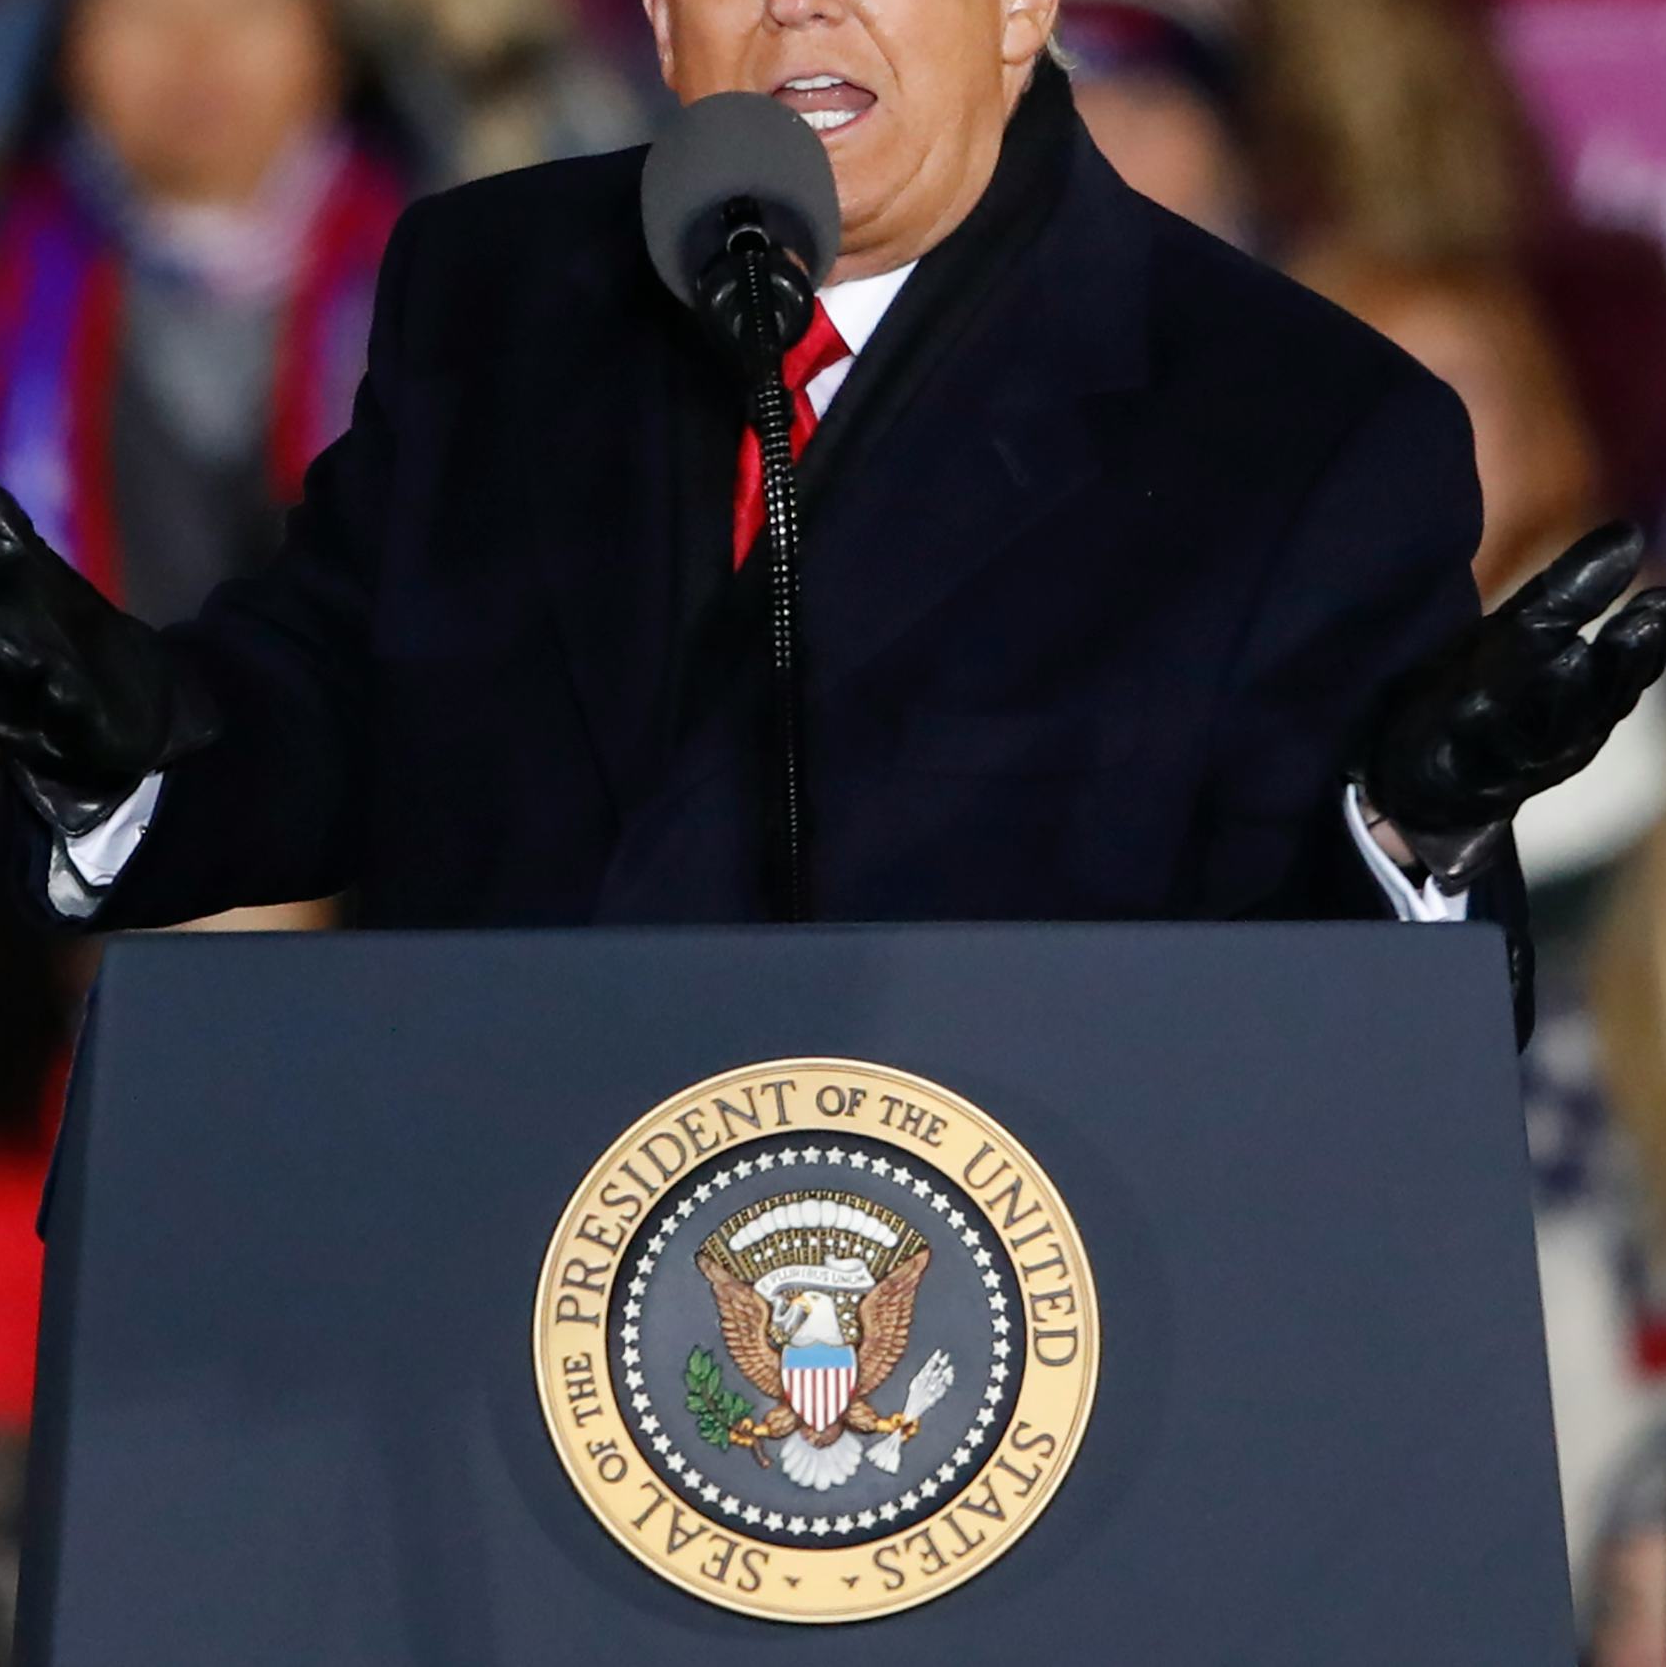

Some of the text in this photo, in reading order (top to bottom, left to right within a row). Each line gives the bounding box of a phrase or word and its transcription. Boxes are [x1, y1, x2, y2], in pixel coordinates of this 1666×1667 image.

[555, 1079, 1078, 1593] SEAL OF THE PRESIDENT OF THE UNITED STATES
